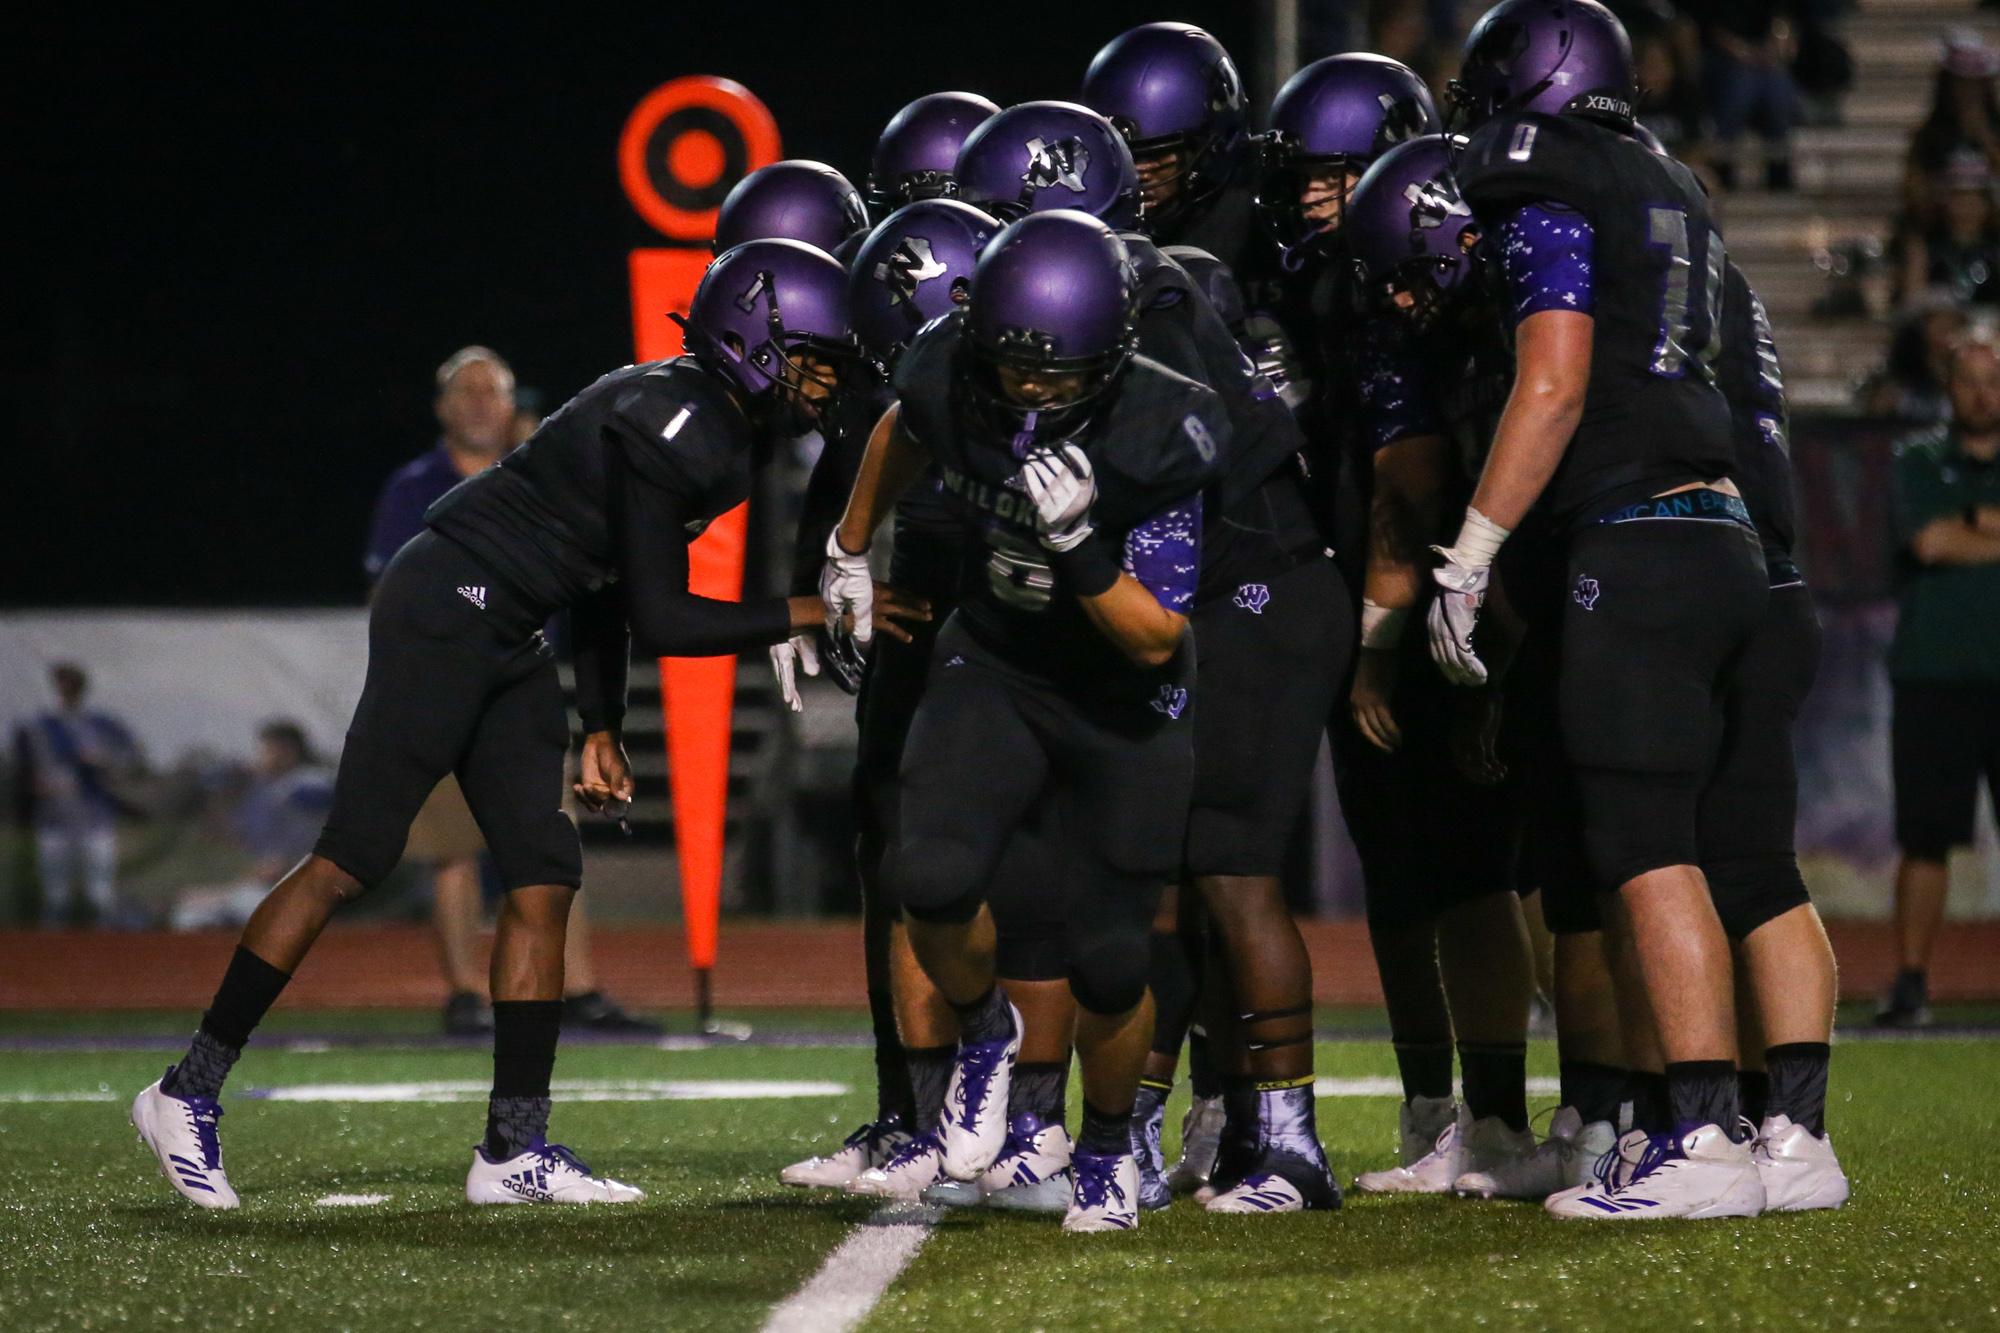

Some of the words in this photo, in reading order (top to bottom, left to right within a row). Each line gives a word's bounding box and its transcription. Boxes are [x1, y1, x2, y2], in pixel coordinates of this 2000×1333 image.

[1585, 95, 1632, 117] XENITH
[660, 402, 698, 442] 1
[943, 466, 1037, 527] WILDK
[502, 1179, 554, 1202] adidas
